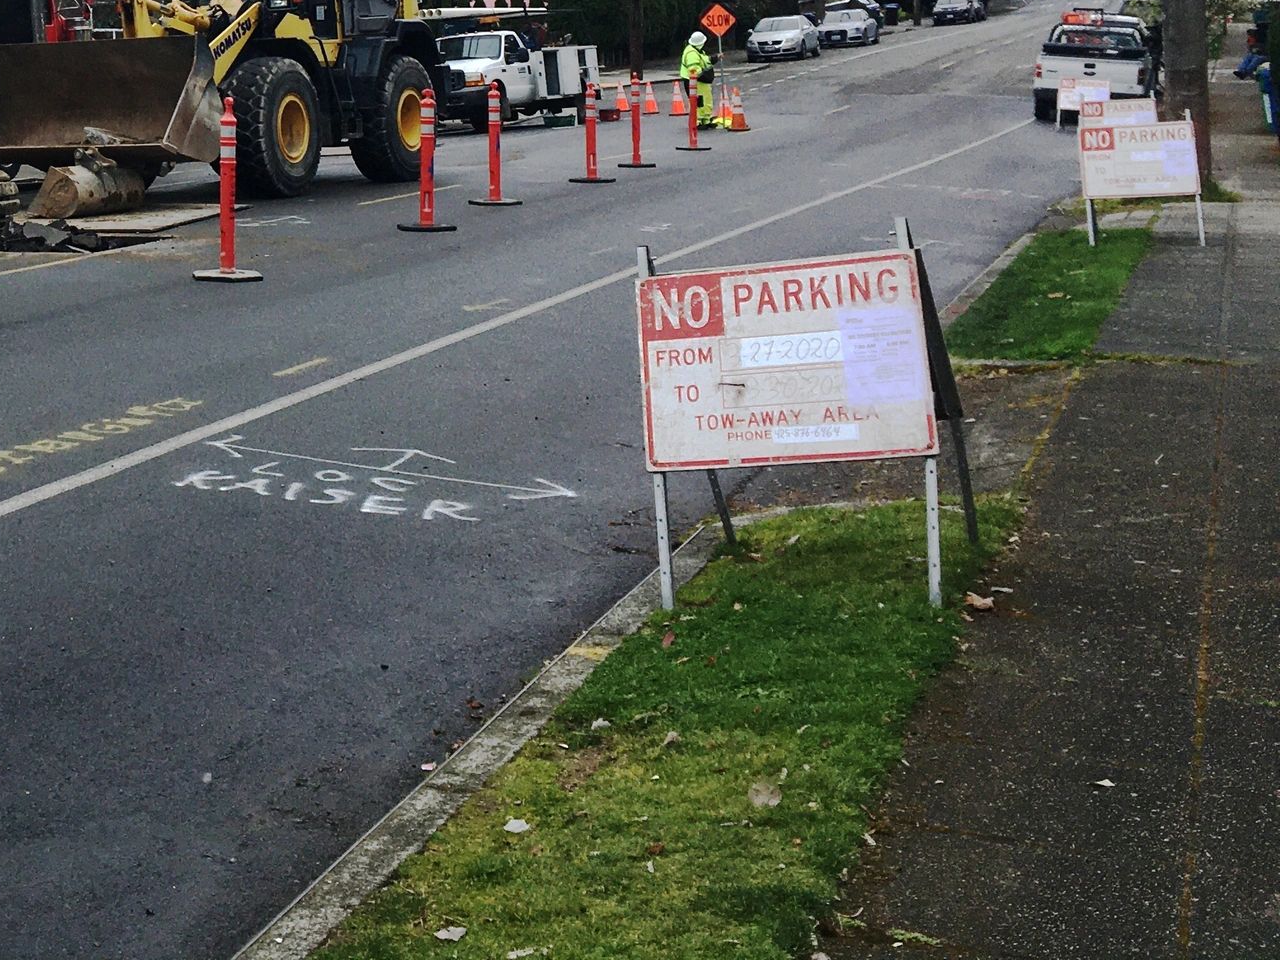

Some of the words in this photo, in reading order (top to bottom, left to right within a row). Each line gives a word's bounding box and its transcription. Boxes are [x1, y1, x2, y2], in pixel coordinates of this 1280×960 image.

[706, 15, 730, 27] SLOW
[213, 17, 251, 60] KOMATSU
[1084, 102, 1103, 116] NO
[1083, 130, 1112, 149] NO
[1118, 127, 1188, 144] PARKING
[652, 282, 710, 331] NO
[733, 268, 899, 317] PARKING
[655, 346, 714, 368] FROM
[673, 384, 700, 403] TO
[694, 409, 802, 431] TOW-AWAY
[727, 430, 772, 442] PHONE
[170, 470, 482, 522] KAISER
